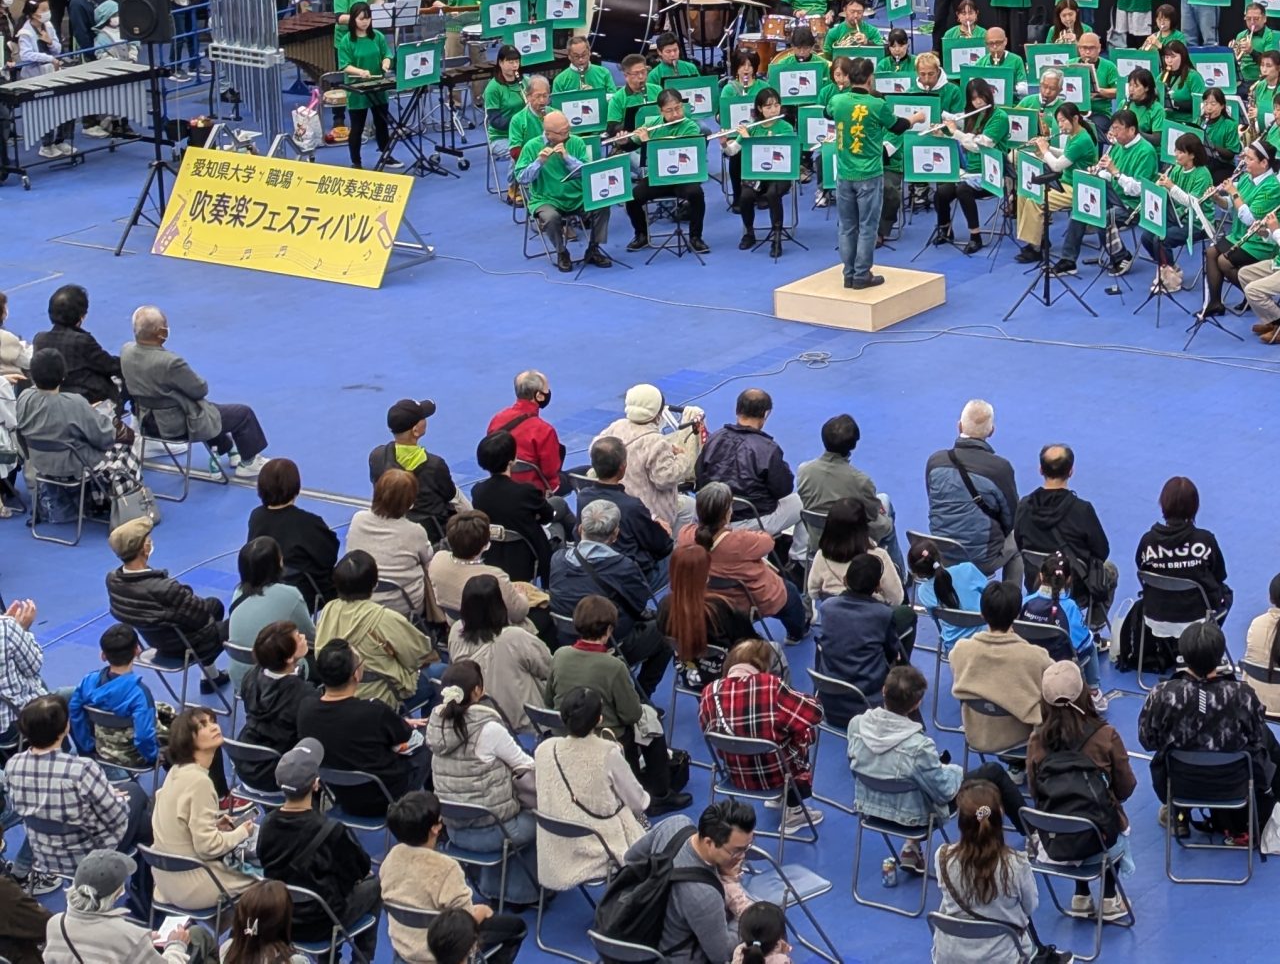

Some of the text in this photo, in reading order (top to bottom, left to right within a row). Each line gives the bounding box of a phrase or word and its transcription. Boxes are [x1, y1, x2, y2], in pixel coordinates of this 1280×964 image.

[189, 189, 374, 245] 吹奏楽フェスティバル
[1168, 559, 1202, 569] BRITISH
